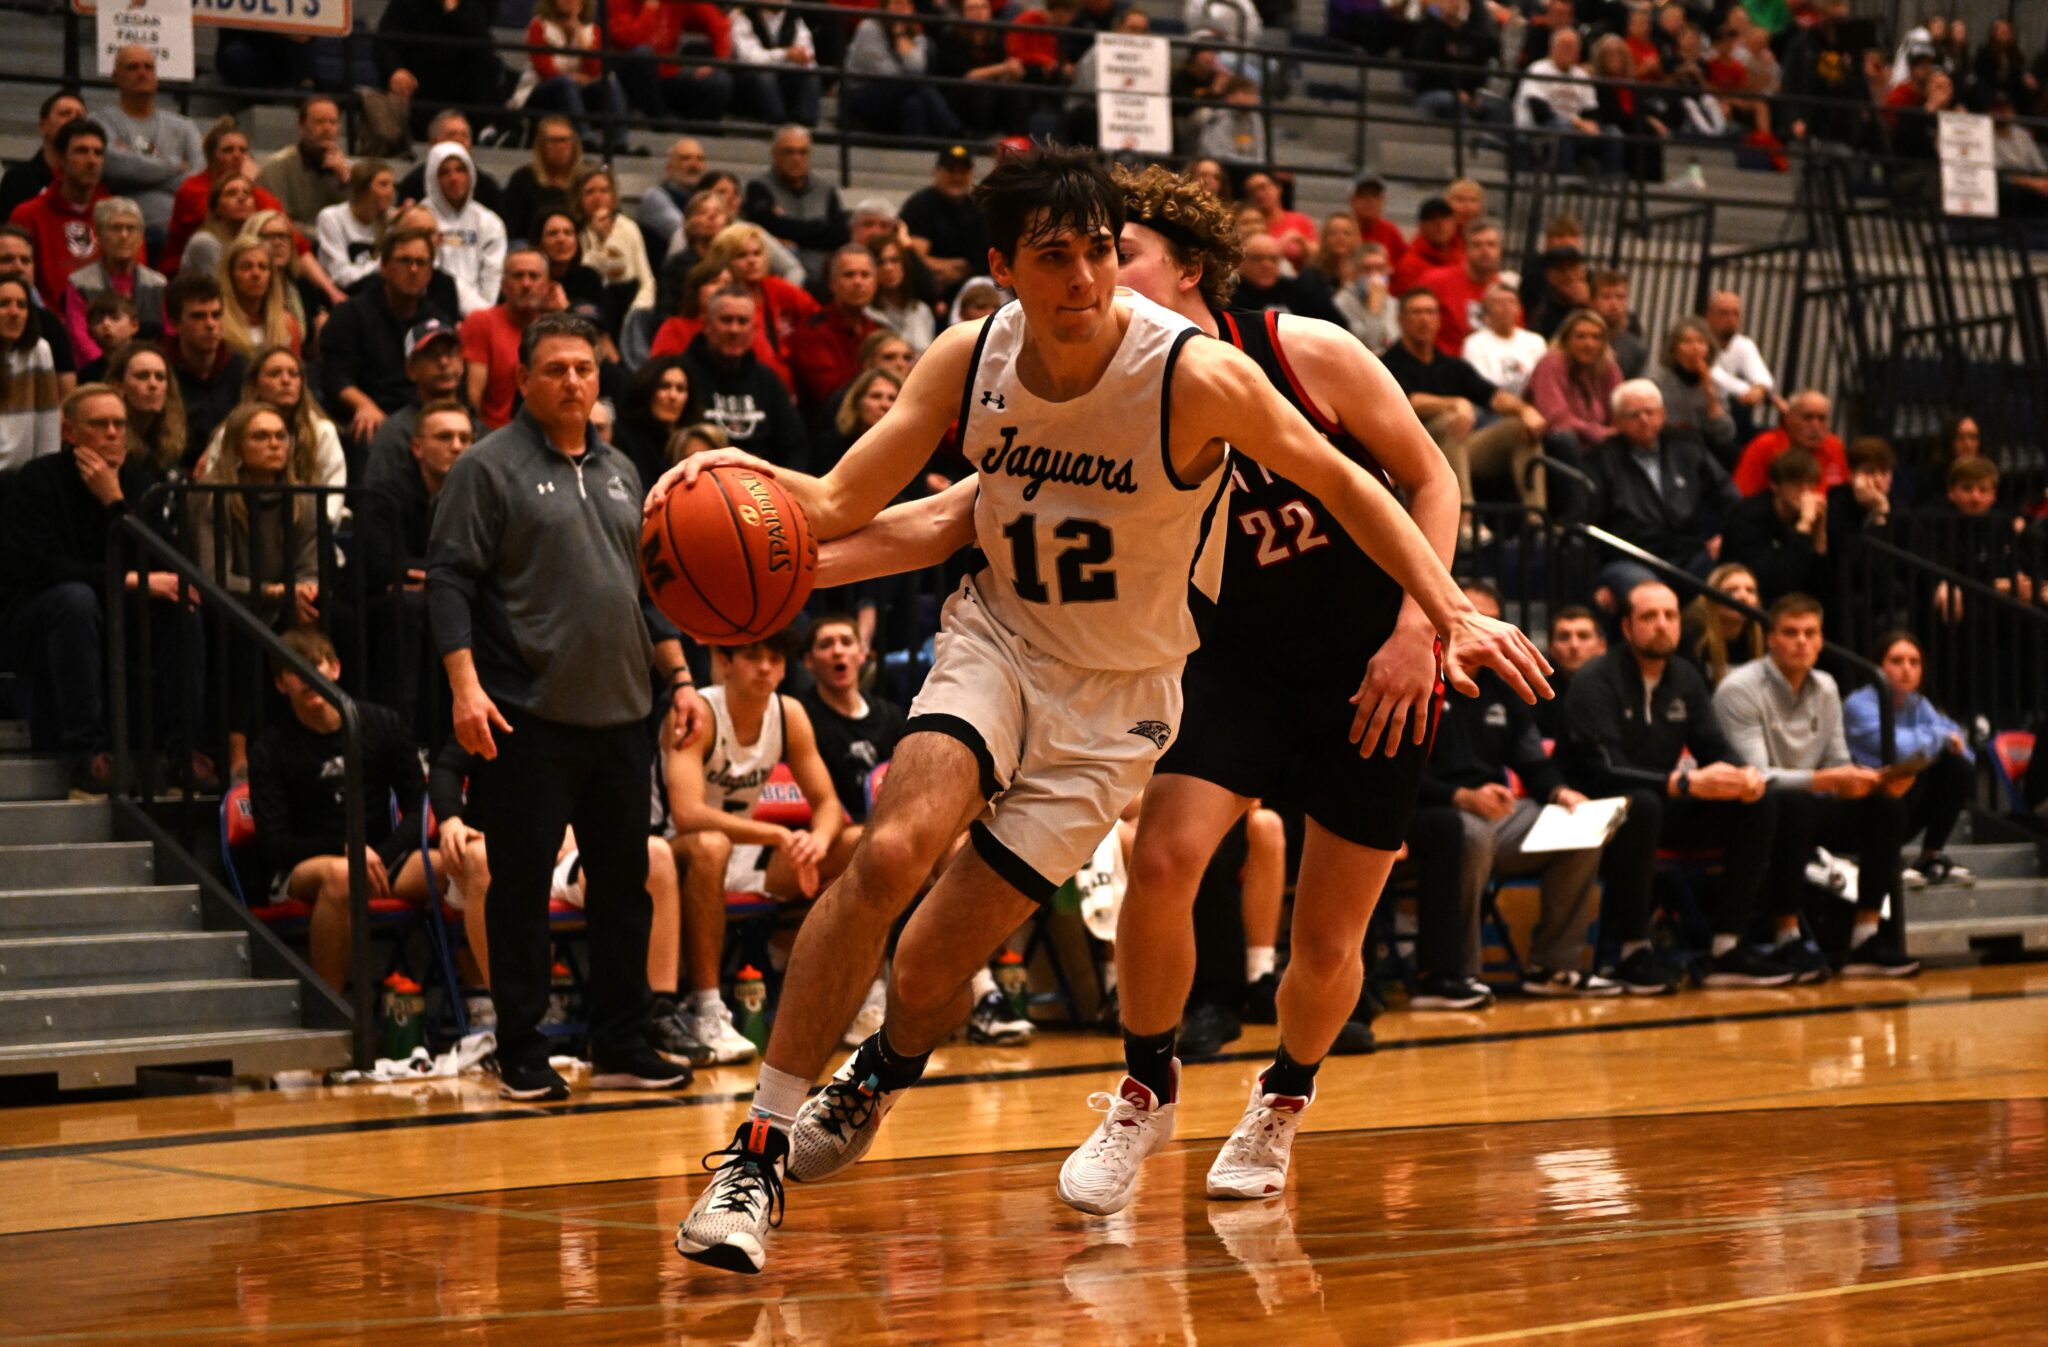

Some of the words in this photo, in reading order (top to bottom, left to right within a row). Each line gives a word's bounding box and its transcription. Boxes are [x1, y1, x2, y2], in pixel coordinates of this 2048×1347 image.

[981, 426, 1138, 501] Jaguars
[731, 472, 792, 574] SPALDING
[1003, 511, 1118, 605] 12
[1237, 499, 1330, 568] 22
